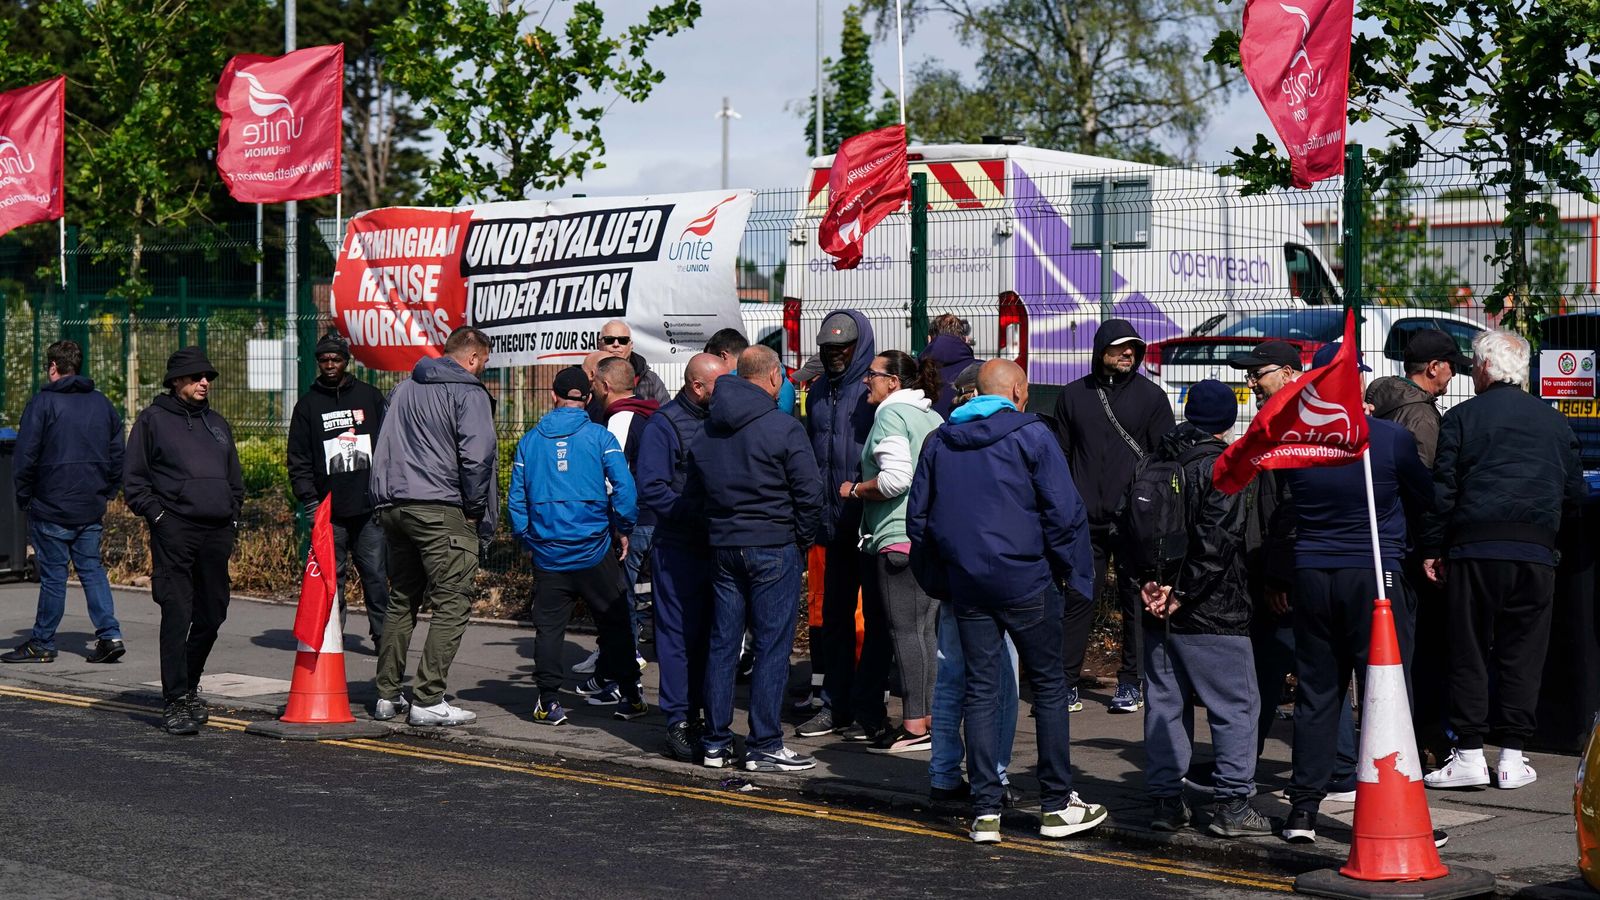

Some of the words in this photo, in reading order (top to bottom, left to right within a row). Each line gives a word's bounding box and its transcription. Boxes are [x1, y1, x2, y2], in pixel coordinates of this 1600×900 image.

[466, 210, 663, 268] UNDERVALUED
[668, 238, 713, 260] unite
[1170, 250, 1272, 285] openreach
[474, 281, 542, 323] UNDER
[538, 272, 629, 315] ATTACK
[343, 308, 453, 347] WORKERS
[540, 331, 554, 351] TO
[555, 331, 579, 351] OUR
[1543, 379, 1552, 387] No
[1553, 379, 1592, 387] unauthorised
[557, 451, 567, 459] 97
